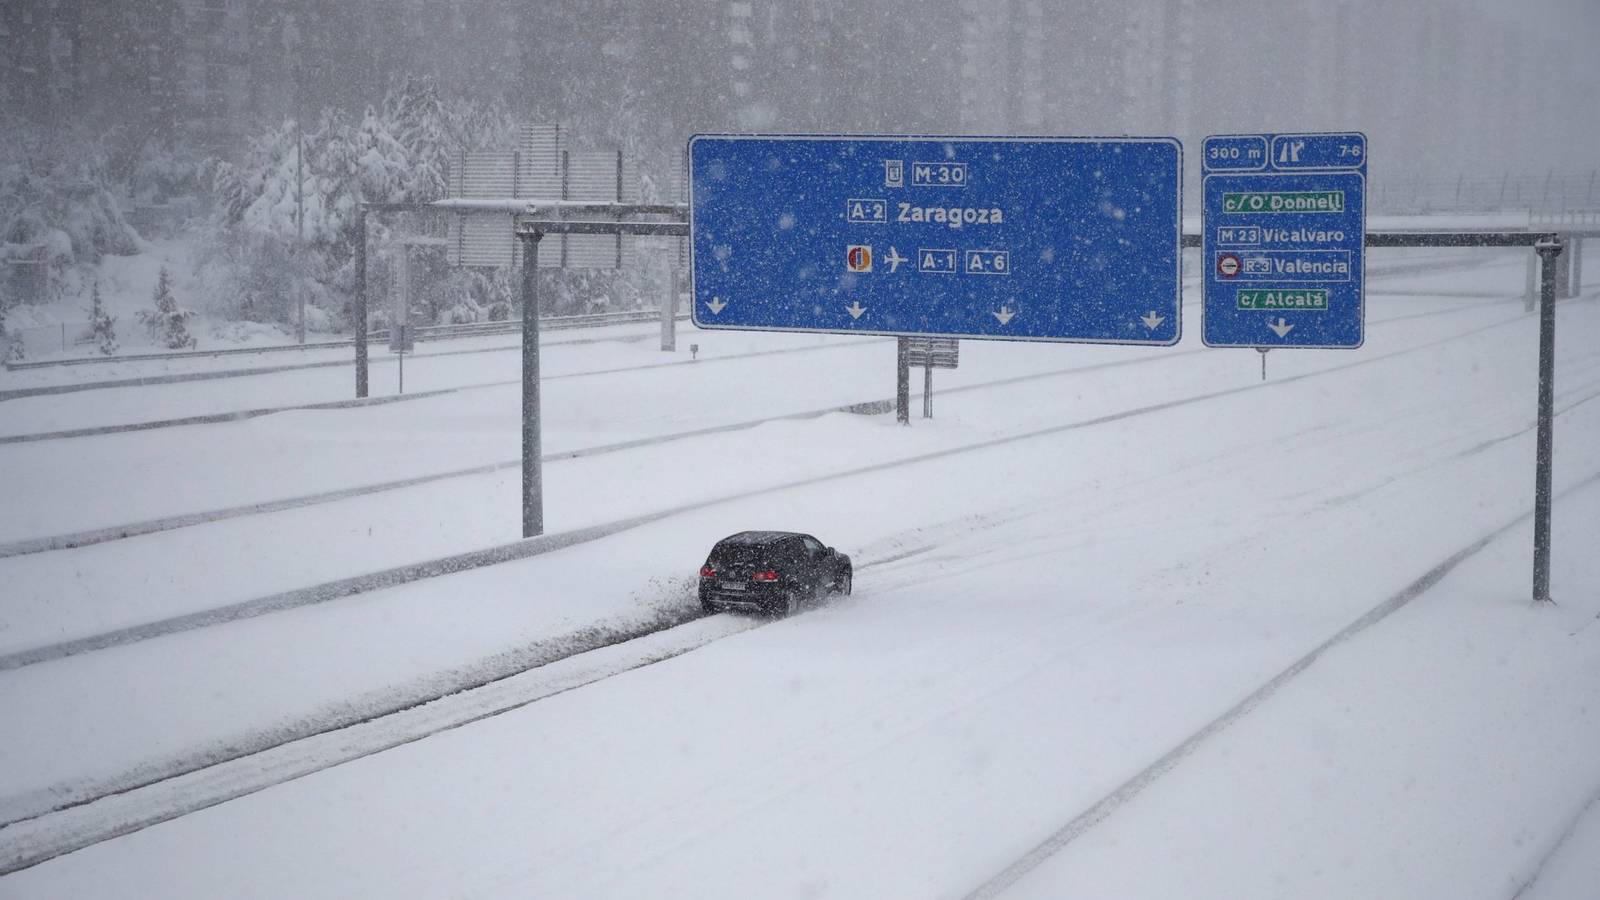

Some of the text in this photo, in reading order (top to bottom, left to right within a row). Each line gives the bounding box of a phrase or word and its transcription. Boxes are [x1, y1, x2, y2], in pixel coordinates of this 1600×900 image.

[1210, 147, 1260, 159] 300 m
[915, 166, 964, 183] M-30
[851, 202, 1003, 228] A-2 Zaragoza
[922, 253, 1005, 271] A-1 A-6
[1246, 260, 1270, 272] R-3
[1274, 258, 1348, 274] Valencia
